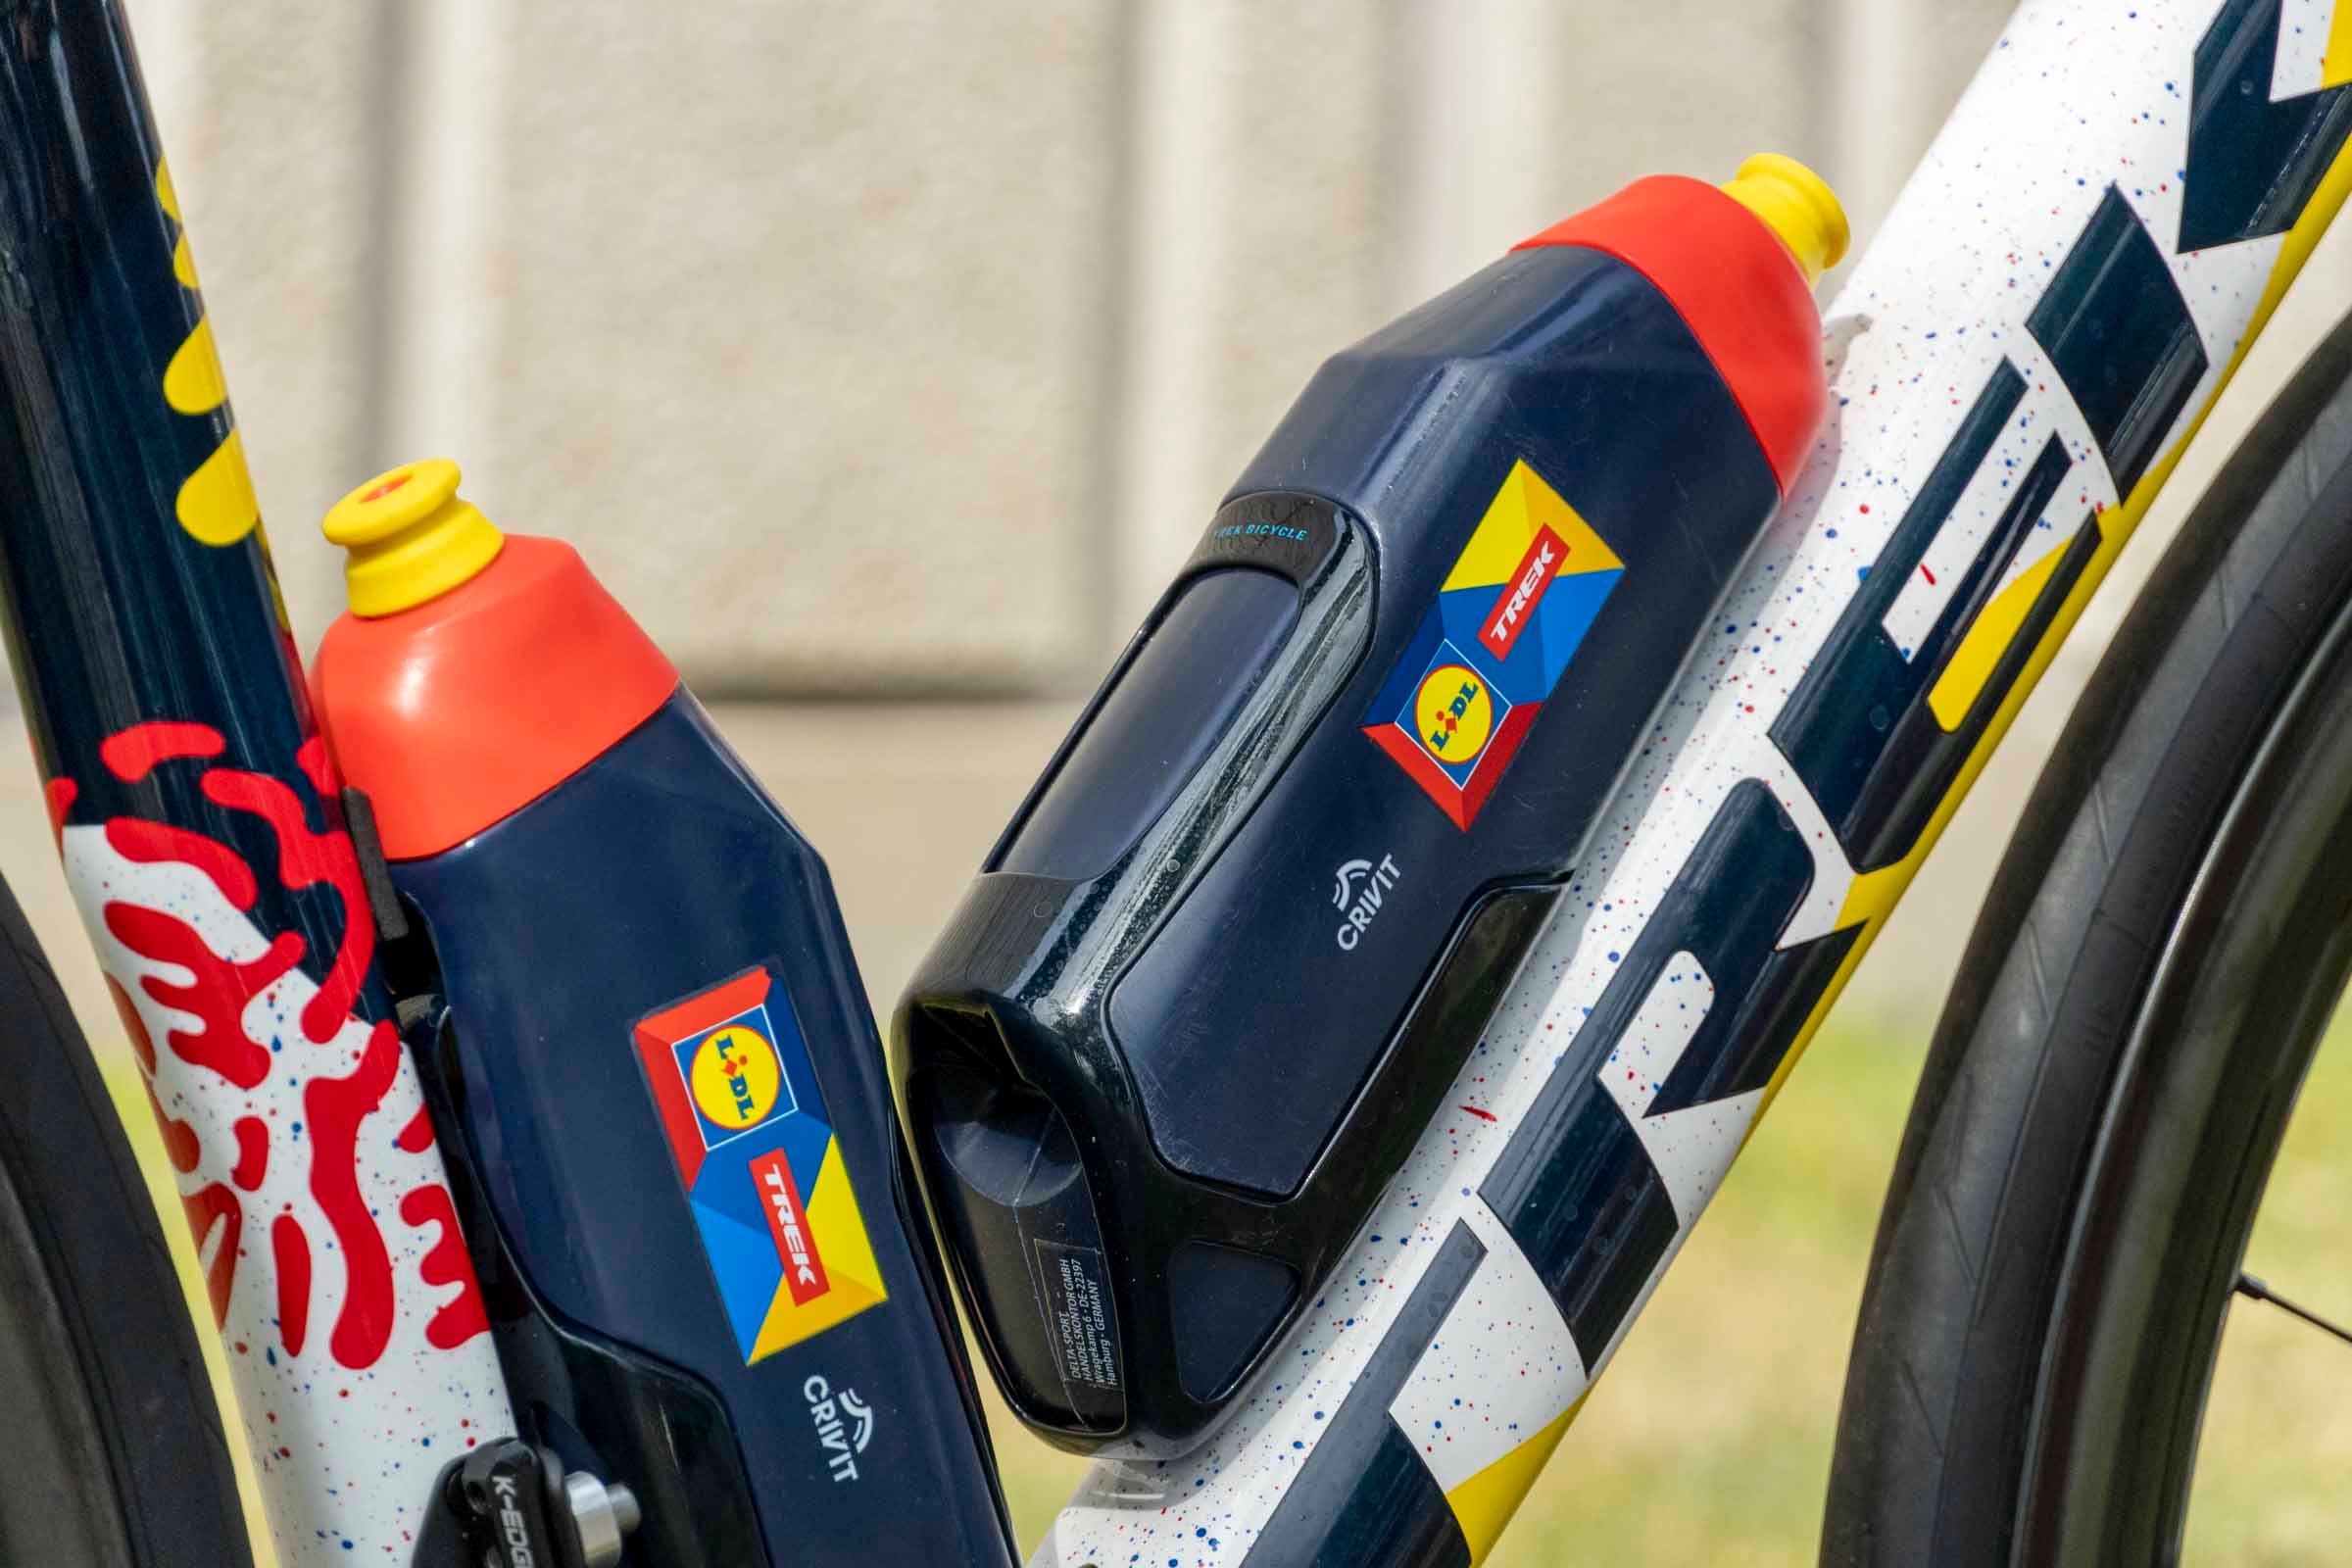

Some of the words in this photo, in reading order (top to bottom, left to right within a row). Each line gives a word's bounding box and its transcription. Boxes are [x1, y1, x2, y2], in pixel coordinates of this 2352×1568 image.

[1246, 524, 1308, 541] BICYCLE
[1490, 540, 1556, 642] TREK
[1337, 854, 1401, 952] CRIVIT
[764, 1163, 816, 1285] TREK
[1059, 1258, 1074, 1291] GMBH
[1071, 1258, 1089, 1308] DE-22397
[1087, 1278, 1105, 1331] GERMANY
[1058, 1310, 1081, 1380] DELTA-SPORT
[1065, 1292, 1093, 1381] HANDELSKONTOR
[1086, 1323, 1105, 1384] Wragekamp
[1101, 1339, 1118, 1386] Hamburg
[804, 1375, 858, 1482] CRIVIT
